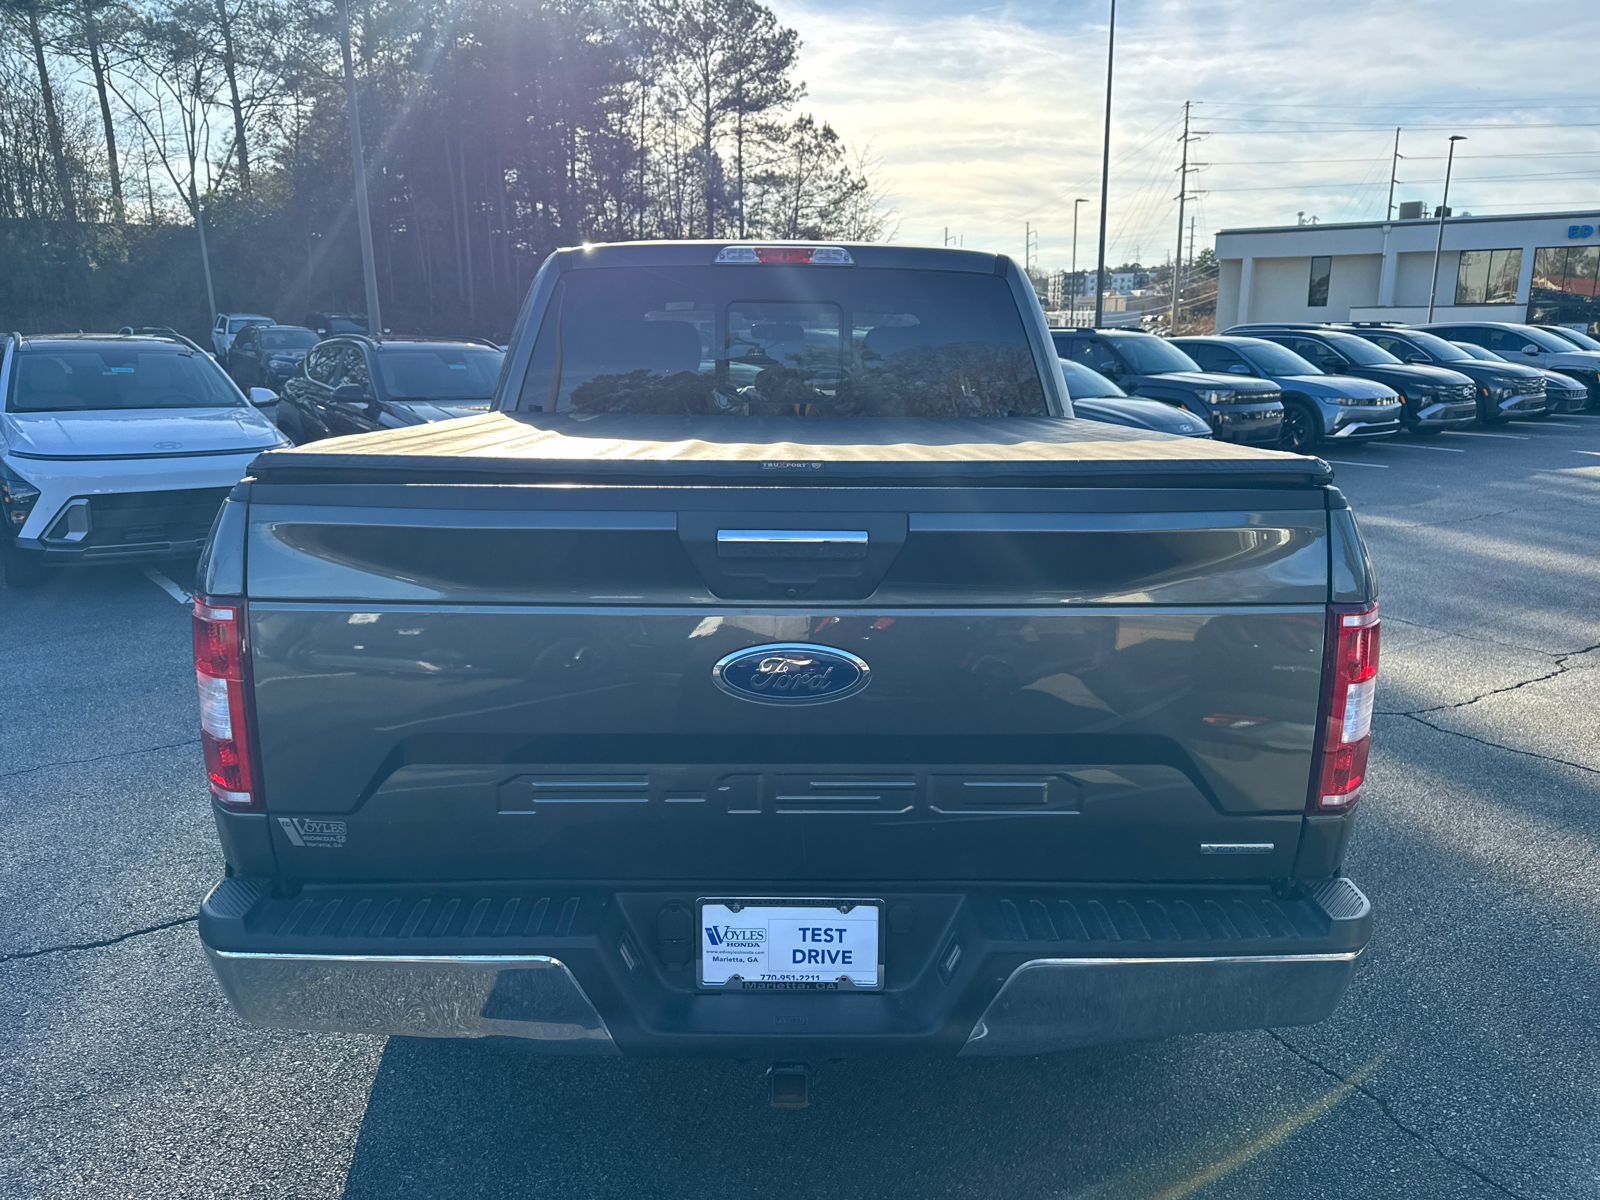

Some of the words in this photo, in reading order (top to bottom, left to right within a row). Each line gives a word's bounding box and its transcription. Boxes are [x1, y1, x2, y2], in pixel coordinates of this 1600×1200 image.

[1567, 225, 1594, 239] ED
[750, 656, 834, 691] Ford
[291, 818, 346, 835] VOYLES
[712, 926, 765, 944] VOYLES
[798, 927, 847, 943] TEST
[792, 949, 853, 965] DRIVE
[815, 982, 836, 990] GA
